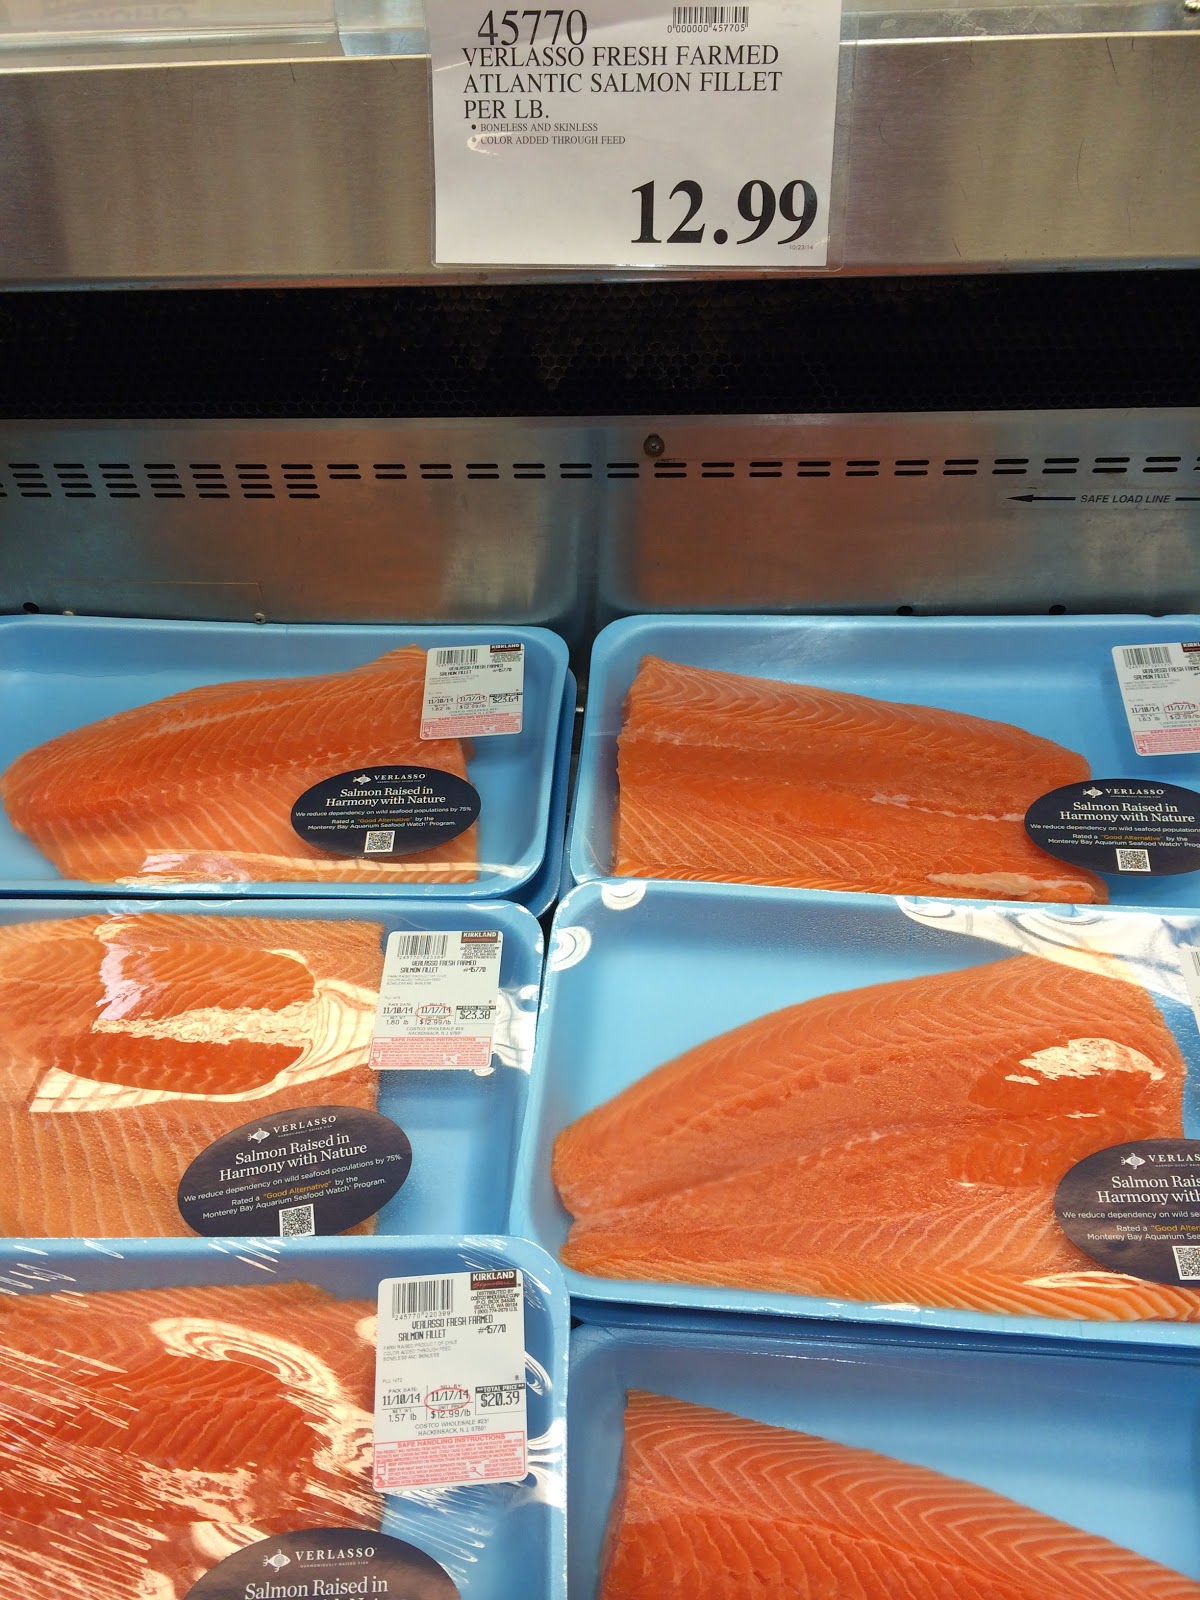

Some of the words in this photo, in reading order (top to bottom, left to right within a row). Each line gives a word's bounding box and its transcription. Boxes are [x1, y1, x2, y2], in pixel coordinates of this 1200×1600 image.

[478, 10, 587, 45] 45770
[713, 23, 745, 32] 457705
[462, 47, 584, 67] VERLASSO
[592, 46, 668, 66] FRESH
[676, 45, 779, 65] FARMED
[463, 73, 582, 94] ATLANTIC
[591, 72, 690, 93] SALMON
[700, 71, 782, 91] FILLET
[464, 100, 506, 119] PER
[515, 99, 549, 119] LB.
[481, 123, 527, 132] BONELESS
[530, 123, 551, 132] AND
[553, 123, 598, 132] SKINLESS
[481, 136, 512, 145] COLOR
[516, 136, 549, 144] ADDED
[552, 136, 598, 144] THROUGH
[601, 136, 625, 144] FEED
[631, 179, 818, 245] 12.99
[1080, 495, 1109, 503] SAFE
[1112, 495, 1143, 503] LOAD
[1145, 495, 1170, 503] LINE
[340, 789, 381, 797] Salmon
[385, 787, 420, 796] Raised
[325, 797, 378, 807] Harmony
[380, 796, 405, 805] with
[1073, 802, 1119, 811] Salmon
[1122, 803, 1163, 812] Raised
[1165, 803, 1178, 812] in
[1060, 811, 1119, 822] Harmony
[1120, 813, 1149, 822] with
[1151, 813, 1195, 822] Nature
[273, 1115, 336, 1133] VERLASSO
[235, 1146, 287, 1165] Salmon
[290, 1135, 334, 1155] Raised
[337, 1133, 350, 1144] in
[219, 1163, 285, 1182] Harmony
[287, 1154, 317, 1169] with
[320, 1144, 367, 1162] Nature
[1148, 1154, 1200, 1162] VERLAS
[198, 1190, 223, 1200] reduce
[225, 1180, 271, 1195] dependency
[284, 1175, 299, 1183] wild
[301, 1168, 330, 1180] seafood
[332, 1160, 374, 1175] populations
[375, 1157, 385, 1166] by
[1112, 1176, 1169, 1188] Salmon
[1170, 1175, 1200, 1187] Rais
[231, 1196, 253, 1206] Rated
[263, 1189, 287, 1199] "Good
[289, 1180, 332, 1195] Alternative"
[346, 1175, 358, 1183] the
[202, 1207, 238, 1219] Monterey
[256, 1197, 292, 1210] Aquarium
[294, 1189, 324, 1201] Seafood
[354, 1178, 386, 1190] Program.
[1096, 1190, 1168, 1205] Harmony
[473, 1272, 514, 1281] KIRKLAND
[412, 1318, 444, 1329] VERLASSO
[447, 1316, 466, 1326] FRESH
[469, 1315, 493, 1325] FARMED
[398, 1331, 423, 1341] SALMON
[426, 1329, 446, 1339] FILLET
[383, 1393, 420, 1406] 11/10/14
[431, 1390, 468, 1402] 11/17/14
[481, 1392, 519, 1408] $20.39
[389, 1414, 405, 1422] 1.57
[431, 1409, 470, 1419] $12.99/lb
[417, 1438, 453, 1446] HANDLING
[454, 1434, 505, 1443] INSTRUCTIONS
[296, 1547, 375, 1561] VERLASSO
[245, 1583, 310, 1600] Salmon
[314, 1579, 368, 1597] Raised
[372, 1576, 388, 1592] in
